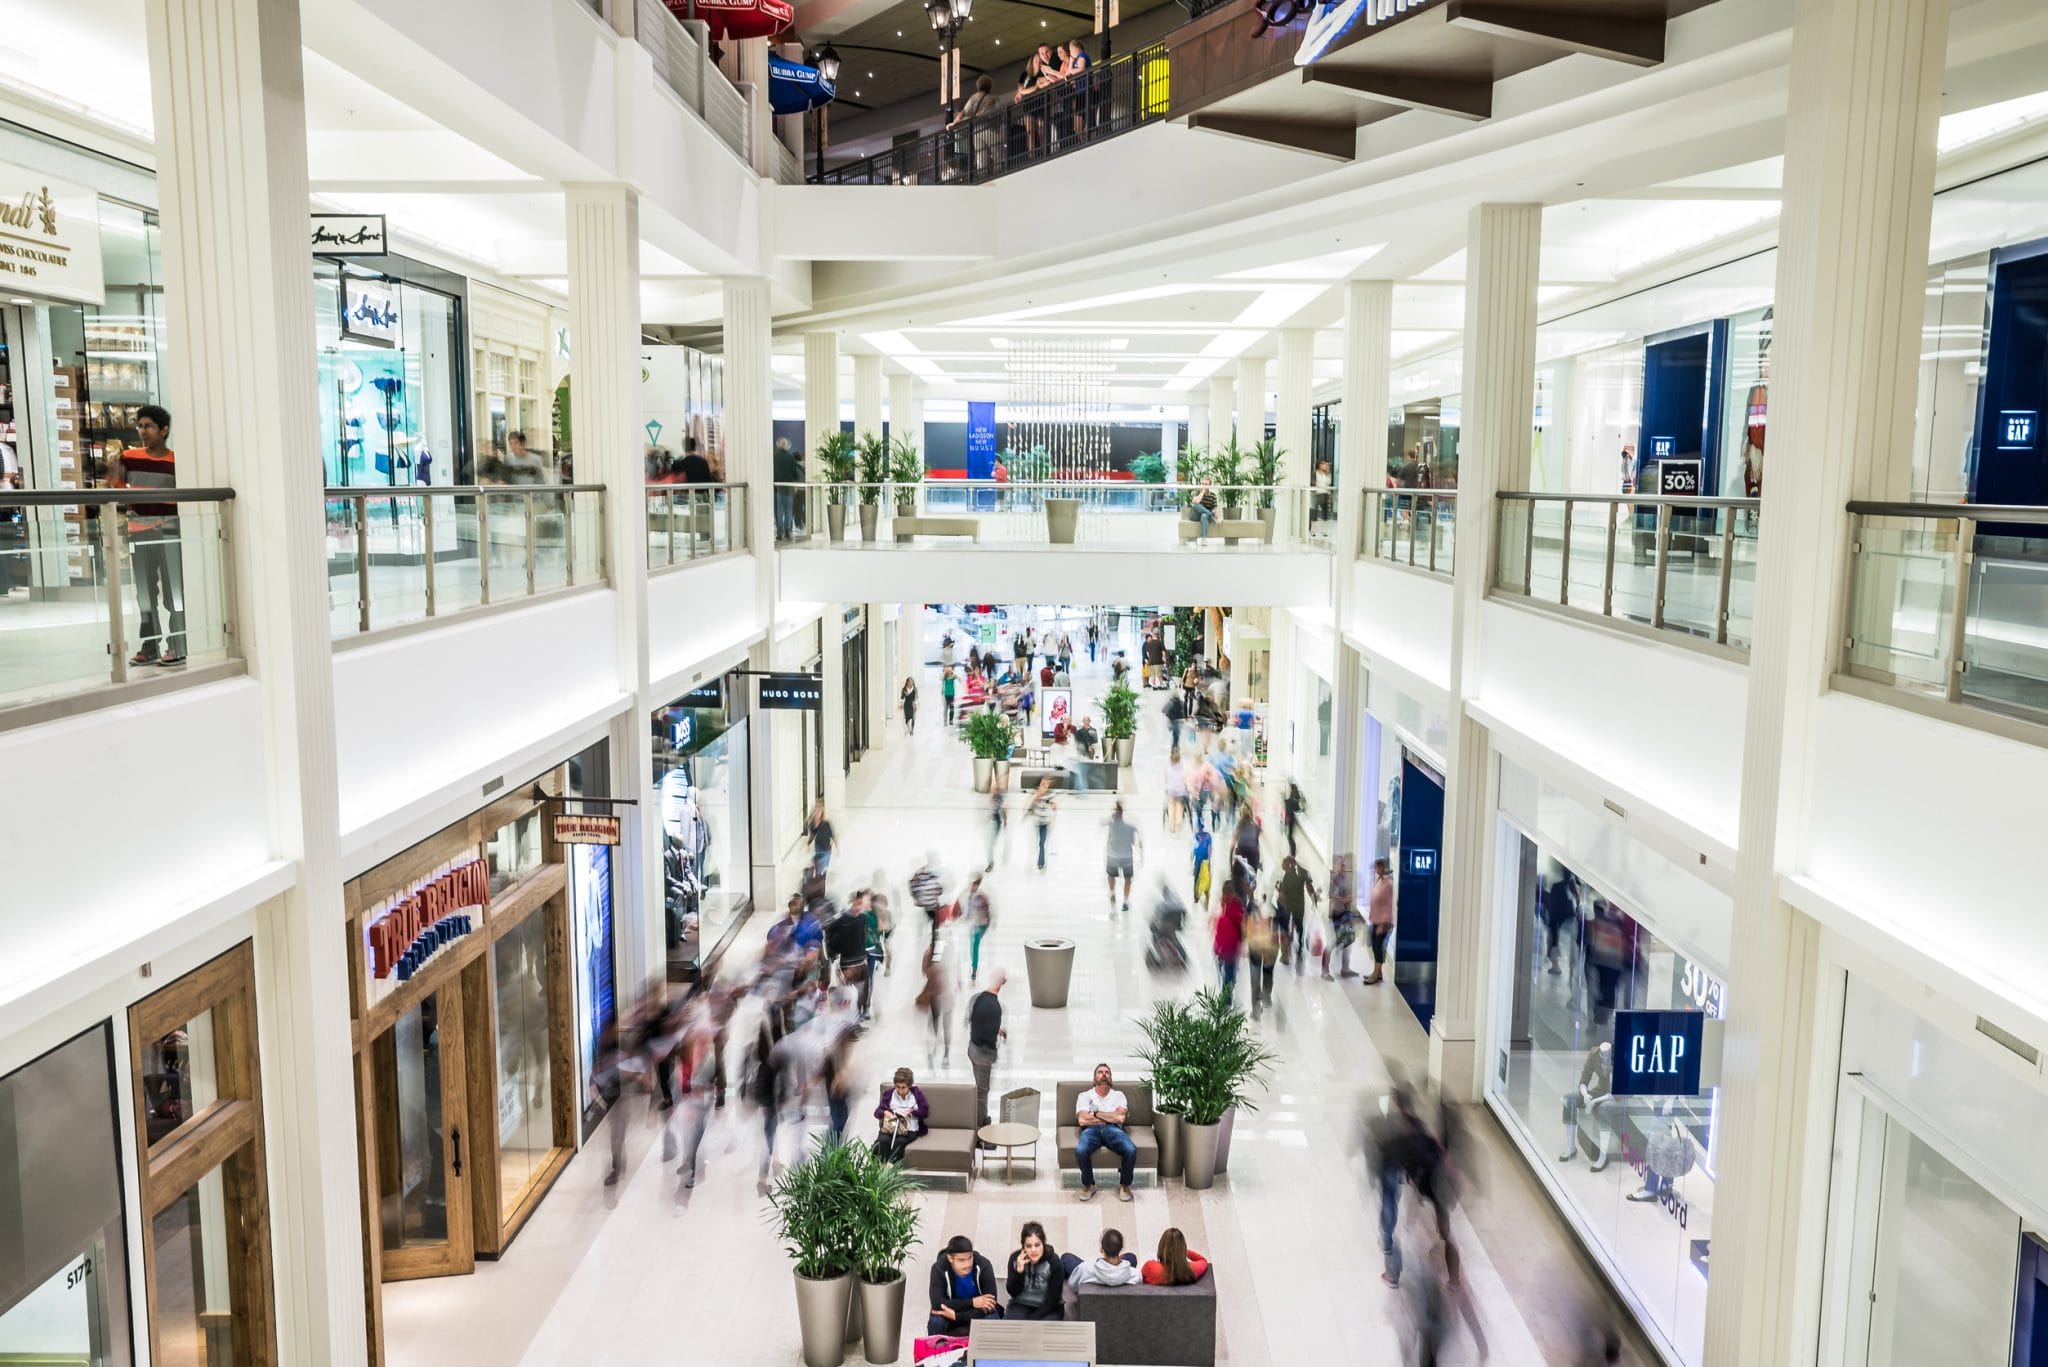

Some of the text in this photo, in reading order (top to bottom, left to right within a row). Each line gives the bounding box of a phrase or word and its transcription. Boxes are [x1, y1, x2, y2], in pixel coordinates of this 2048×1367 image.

[772, 66, 816, 81] BUBBA GUMP
[16, 247, 67, 267] CHOCOLATIER
[19, 264, 37, 277] 1845
[2007, 425, 2029, 441] GAP
[1656, 442, 1670, 451] GAP
[1664, 474, 1696, 490] 30%
[762, 690, 820, 699] HUGO BOSS
[556, 823, 617, 837] TRUE RELIGION
[1415, 855, 1432, 870] GAP
[370, 858, 490, 979] TRUE RELIGION
[1631, 1034, 1686, 1074] GAP
[1660, 1179, 1688, 1231] Cord
[67, 1258, 93, 1290] S172
